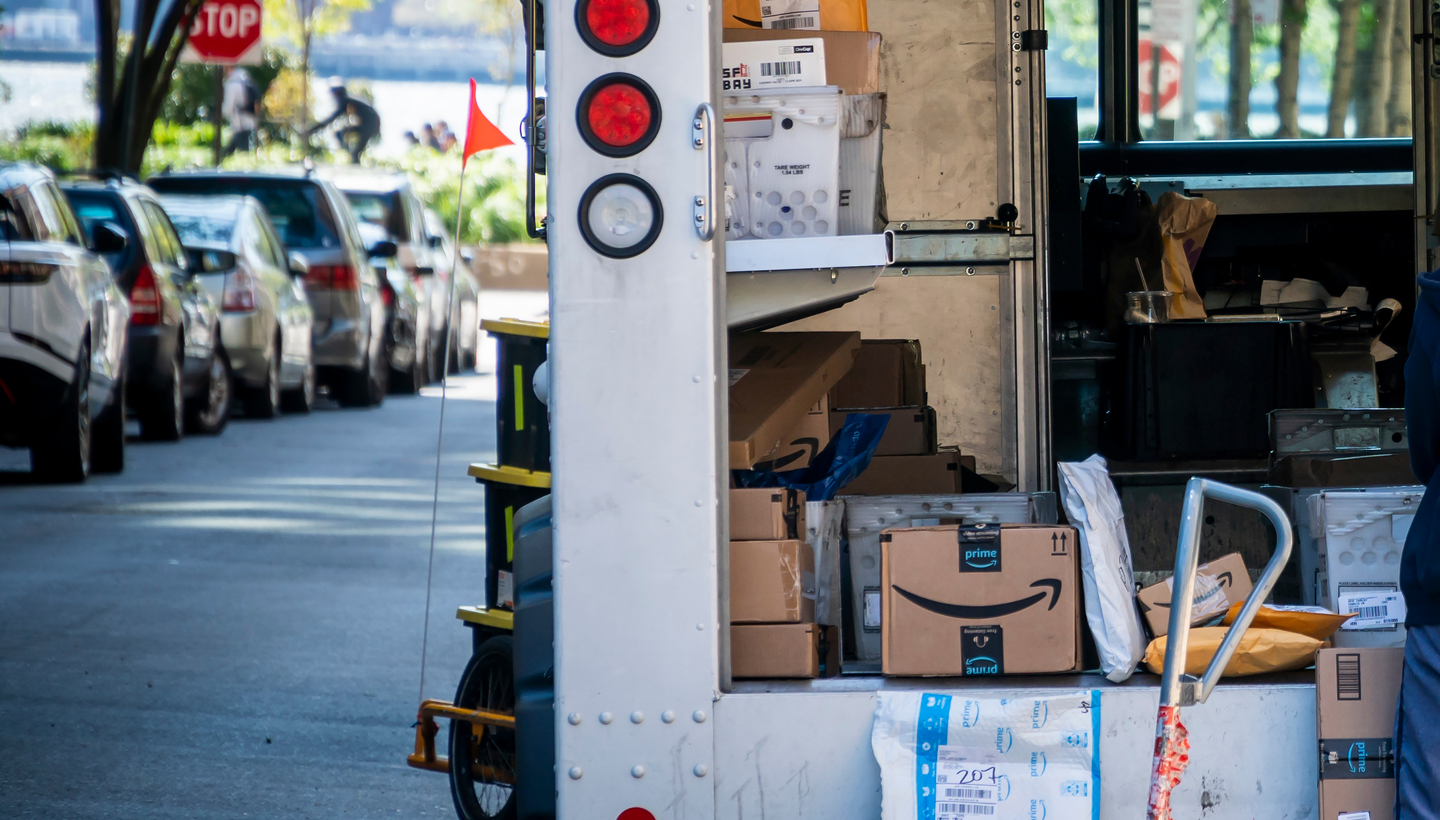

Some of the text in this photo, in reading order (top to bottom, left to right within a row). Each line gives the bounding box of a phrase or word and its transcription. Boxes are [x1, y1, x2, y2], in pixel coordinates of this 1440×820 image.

[722, 67, 741, 78] SF
[723, 79, 751, 90] BAY
[965, 548, 998, 560] prime
[966, 664, 998, 674] prime
[961, 700, 972, 728] prime
[1030, 701, 1041, 729] prime
[1028, 751, 1038, 777] prime
[1356, 742, 1369, 772] prime
[956, 767, 1003, 784] 207
